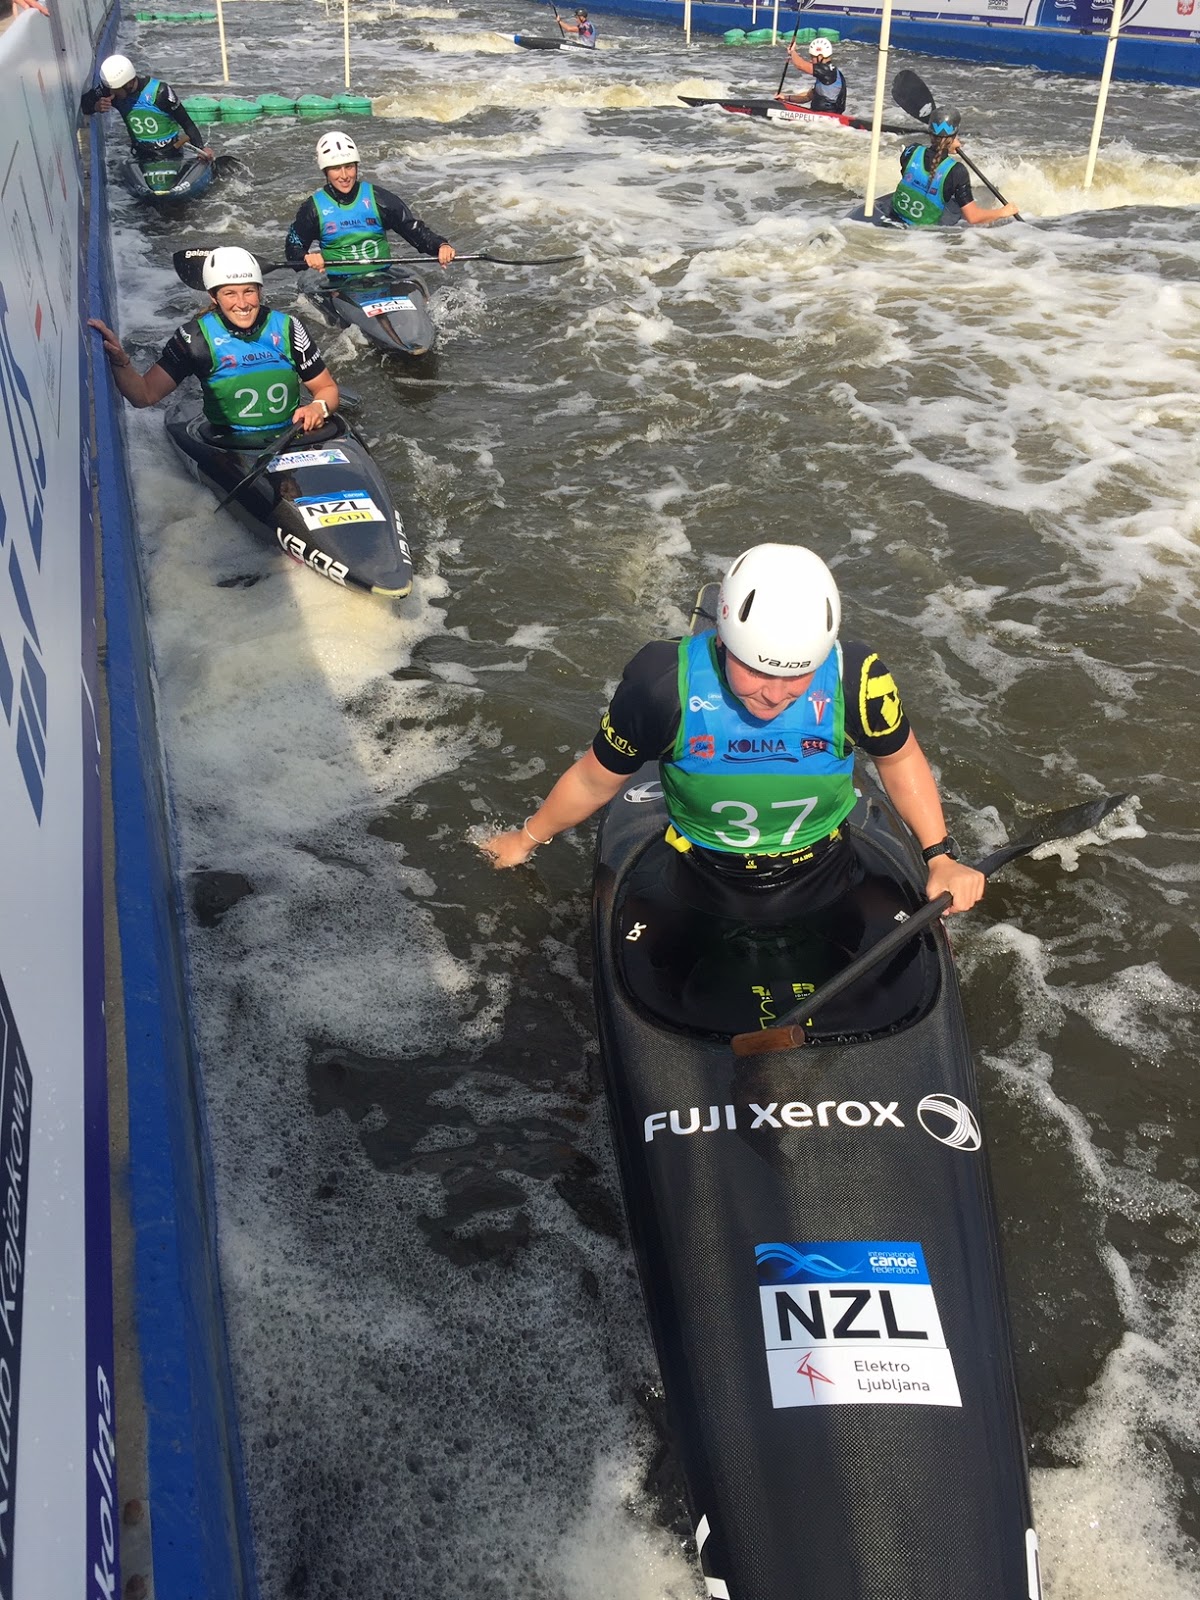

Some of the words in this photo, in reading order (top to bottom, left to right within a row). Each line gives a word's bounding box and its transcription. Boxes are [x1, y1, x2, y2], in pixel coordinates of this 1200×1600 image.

[130, 116, 159, 135] 39
[897, 191, 925, 218] 38
[241, 351, 275, 363] KOLNA
[234, 382, 289, 418] 29
[306, 500, 371, 517] NZL
[727, 738, 787, 754] KOLNA
[710, 796, 819, 848] 37
[644, 1105, 737, 1143] FUJI
[0, 1047, 30, 1346] Kajakowy
[869, 1256, 918, 1268] canoe
[871, 1266, 920, 1275] federation
[774, 1289, 929, 1341] NZL
[854, 1360, 910, 1373] Elektro
[857, 1378, 931, 1394] Ljubljana
